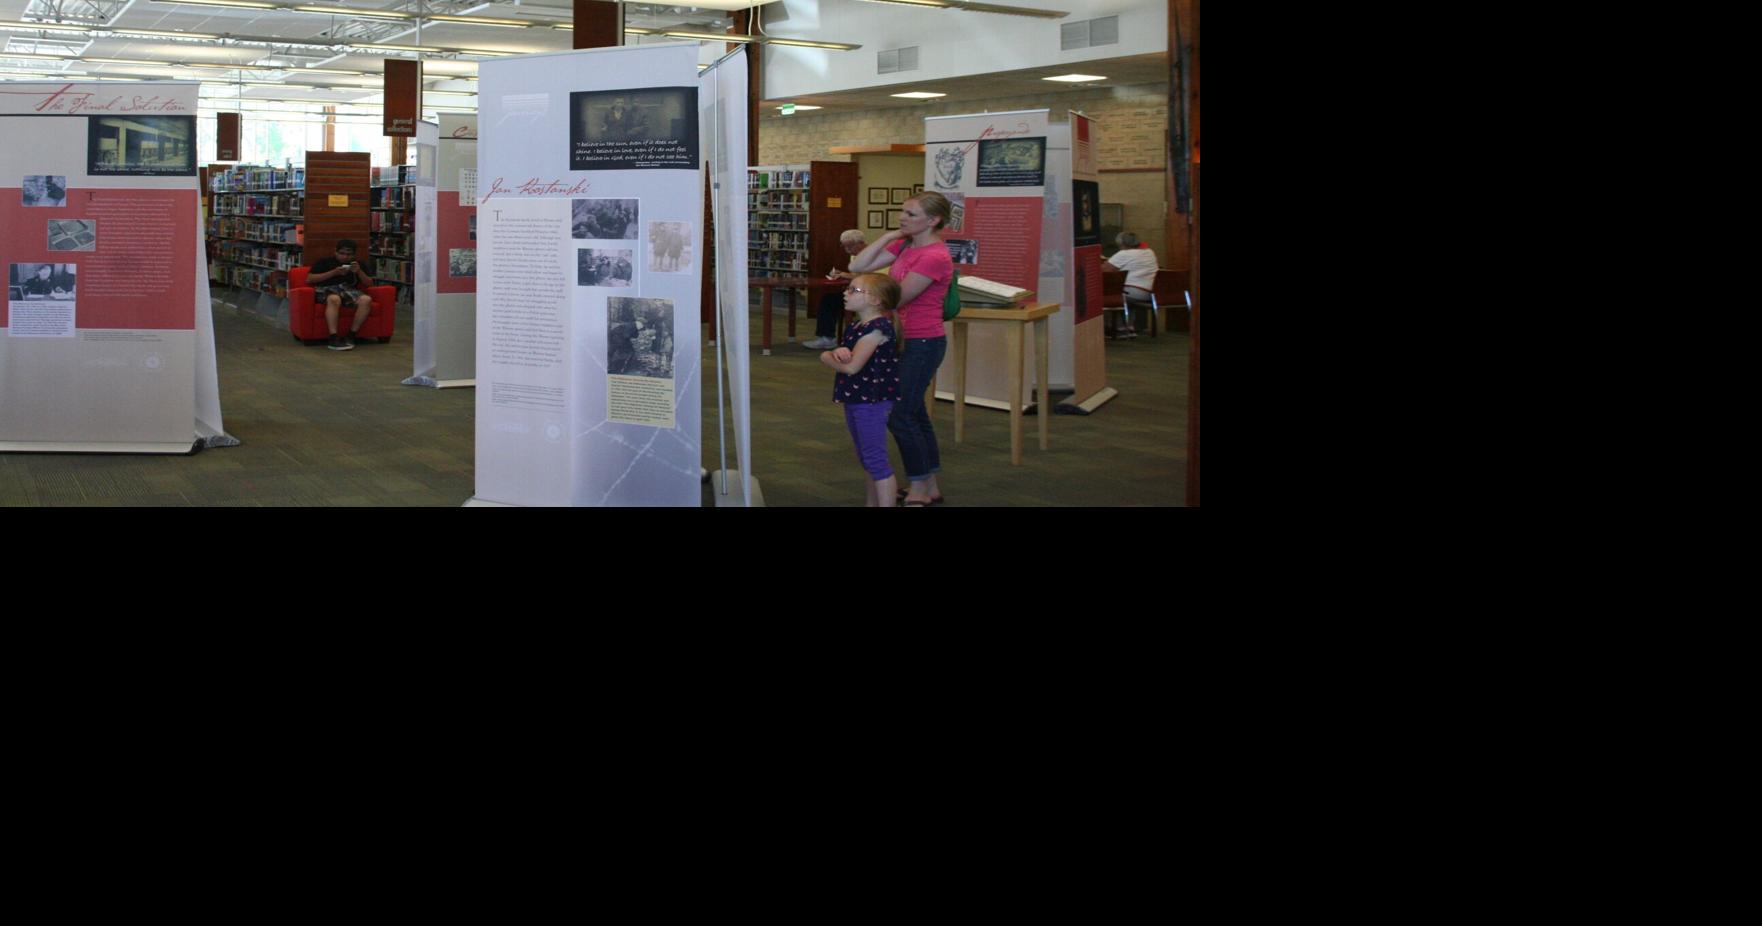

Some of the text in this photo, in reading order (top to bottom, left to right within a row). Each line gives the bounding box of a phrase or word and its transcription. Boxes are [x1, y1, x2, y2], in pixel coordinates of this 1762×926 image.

[69, 93, 116, 114] Final
[120, 95, 188, 112] Solution
[481, 177, 512, 204] Jan
[515, 177, 592, 196] Kostanski
